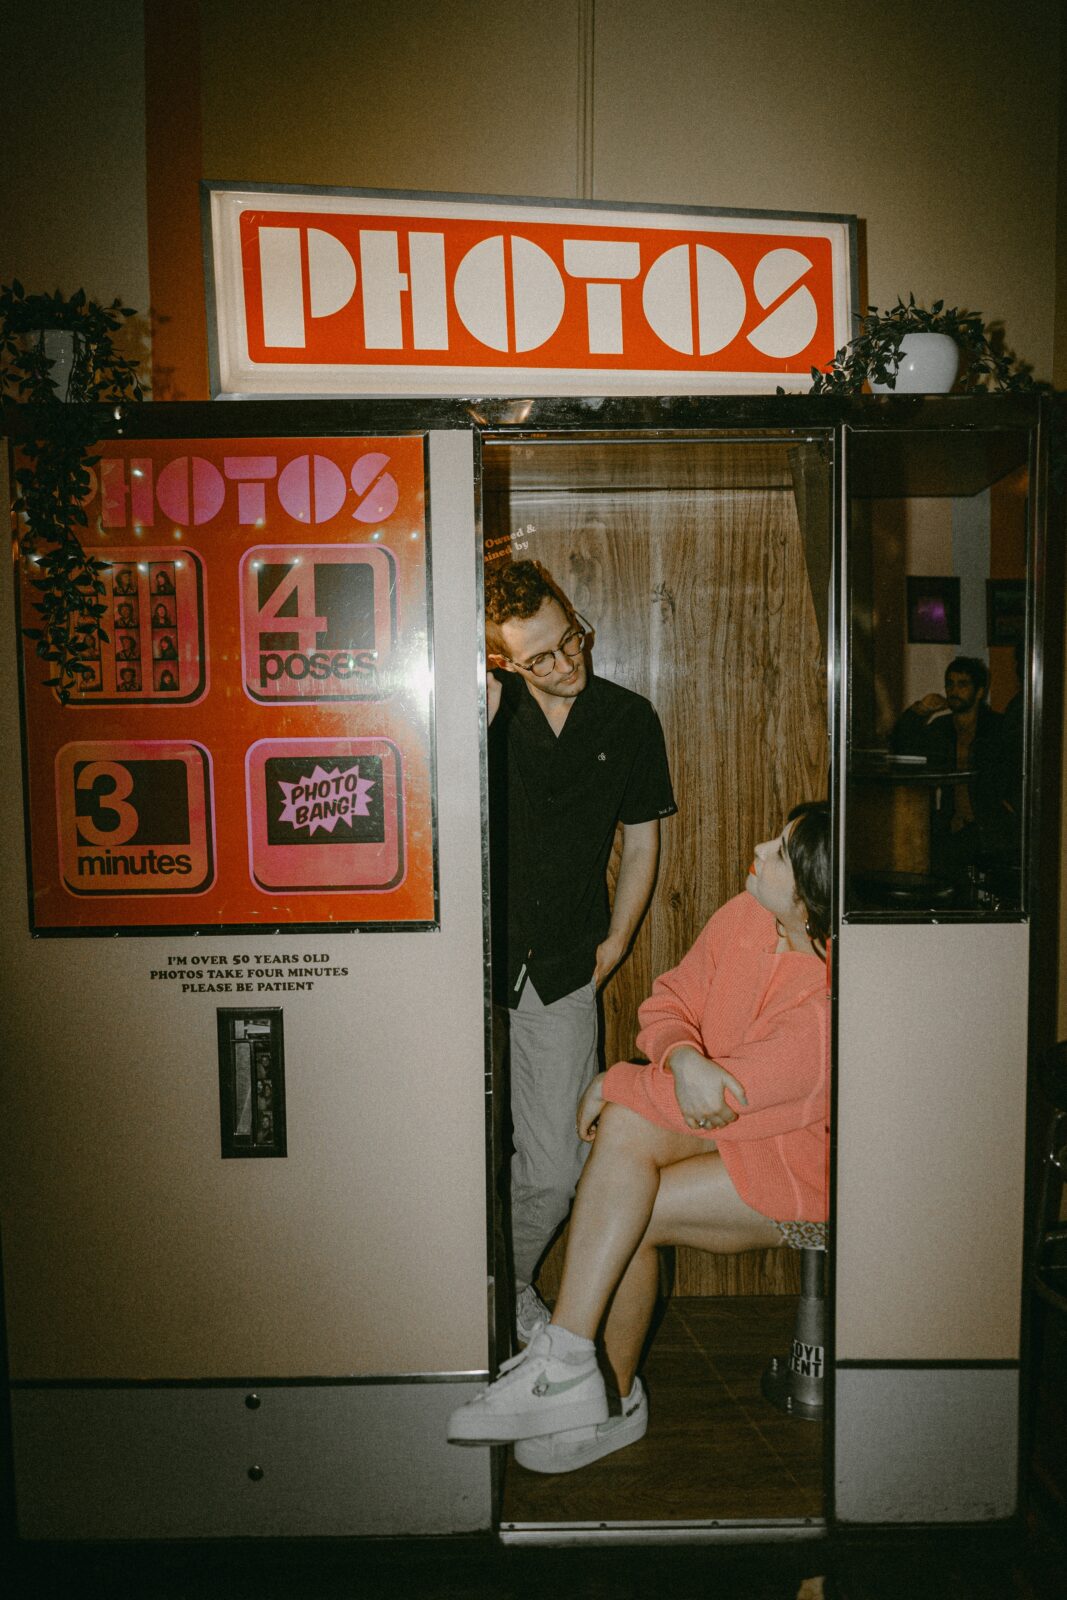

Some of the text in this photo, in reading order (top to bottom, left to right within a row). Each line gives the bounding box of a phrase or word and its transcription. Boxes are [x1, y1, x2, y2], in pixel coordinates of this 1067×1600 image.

[257, 226, 819, 359] PHOTOS
[54, 452, 399, 528] HOTOS
[526, 524, 537, 534] &
[514, 540, 529, 550] by
[257, 563, 328, 652] 4
[259, 652, 377, 688] poses
[291, 774, 358, 805] PHOTO
[76, 761, 139, 846] 3
[295, 793, 358, 825] BANG!
[77, 849, 192, 876] minutes
[167, 953, 330, 966] I'M OVER 50 YEARS OLD
[150, 967, 349, 980] PHOTOS TAKE FOUR MINUTES
[182, 981, 314, 993] PLEASE BE PATIENT
[792, 1342, 823, 1363] OYL
[790, 1356, 823, 1378] ENT
